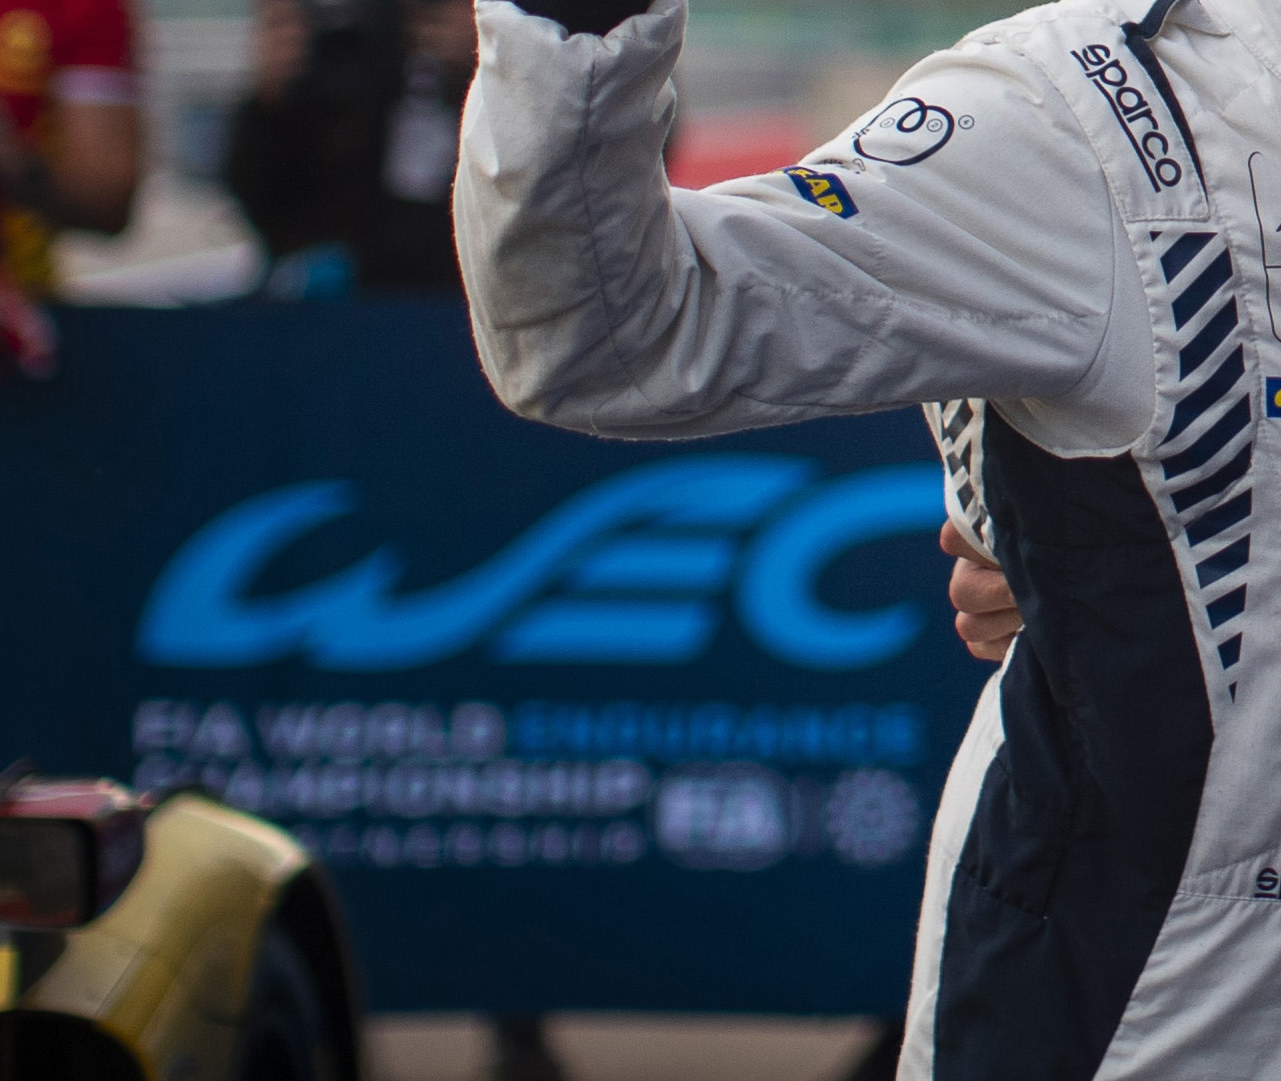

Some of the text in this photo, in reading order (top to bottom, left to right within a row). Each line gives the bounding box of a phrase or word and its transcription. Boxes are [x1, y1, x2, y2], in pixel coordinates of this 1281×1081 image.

[1082, 44, 1182, 189] sparco
[134, 452, 945, 671] WEC
[260, 702, 508, 760] WORLD
